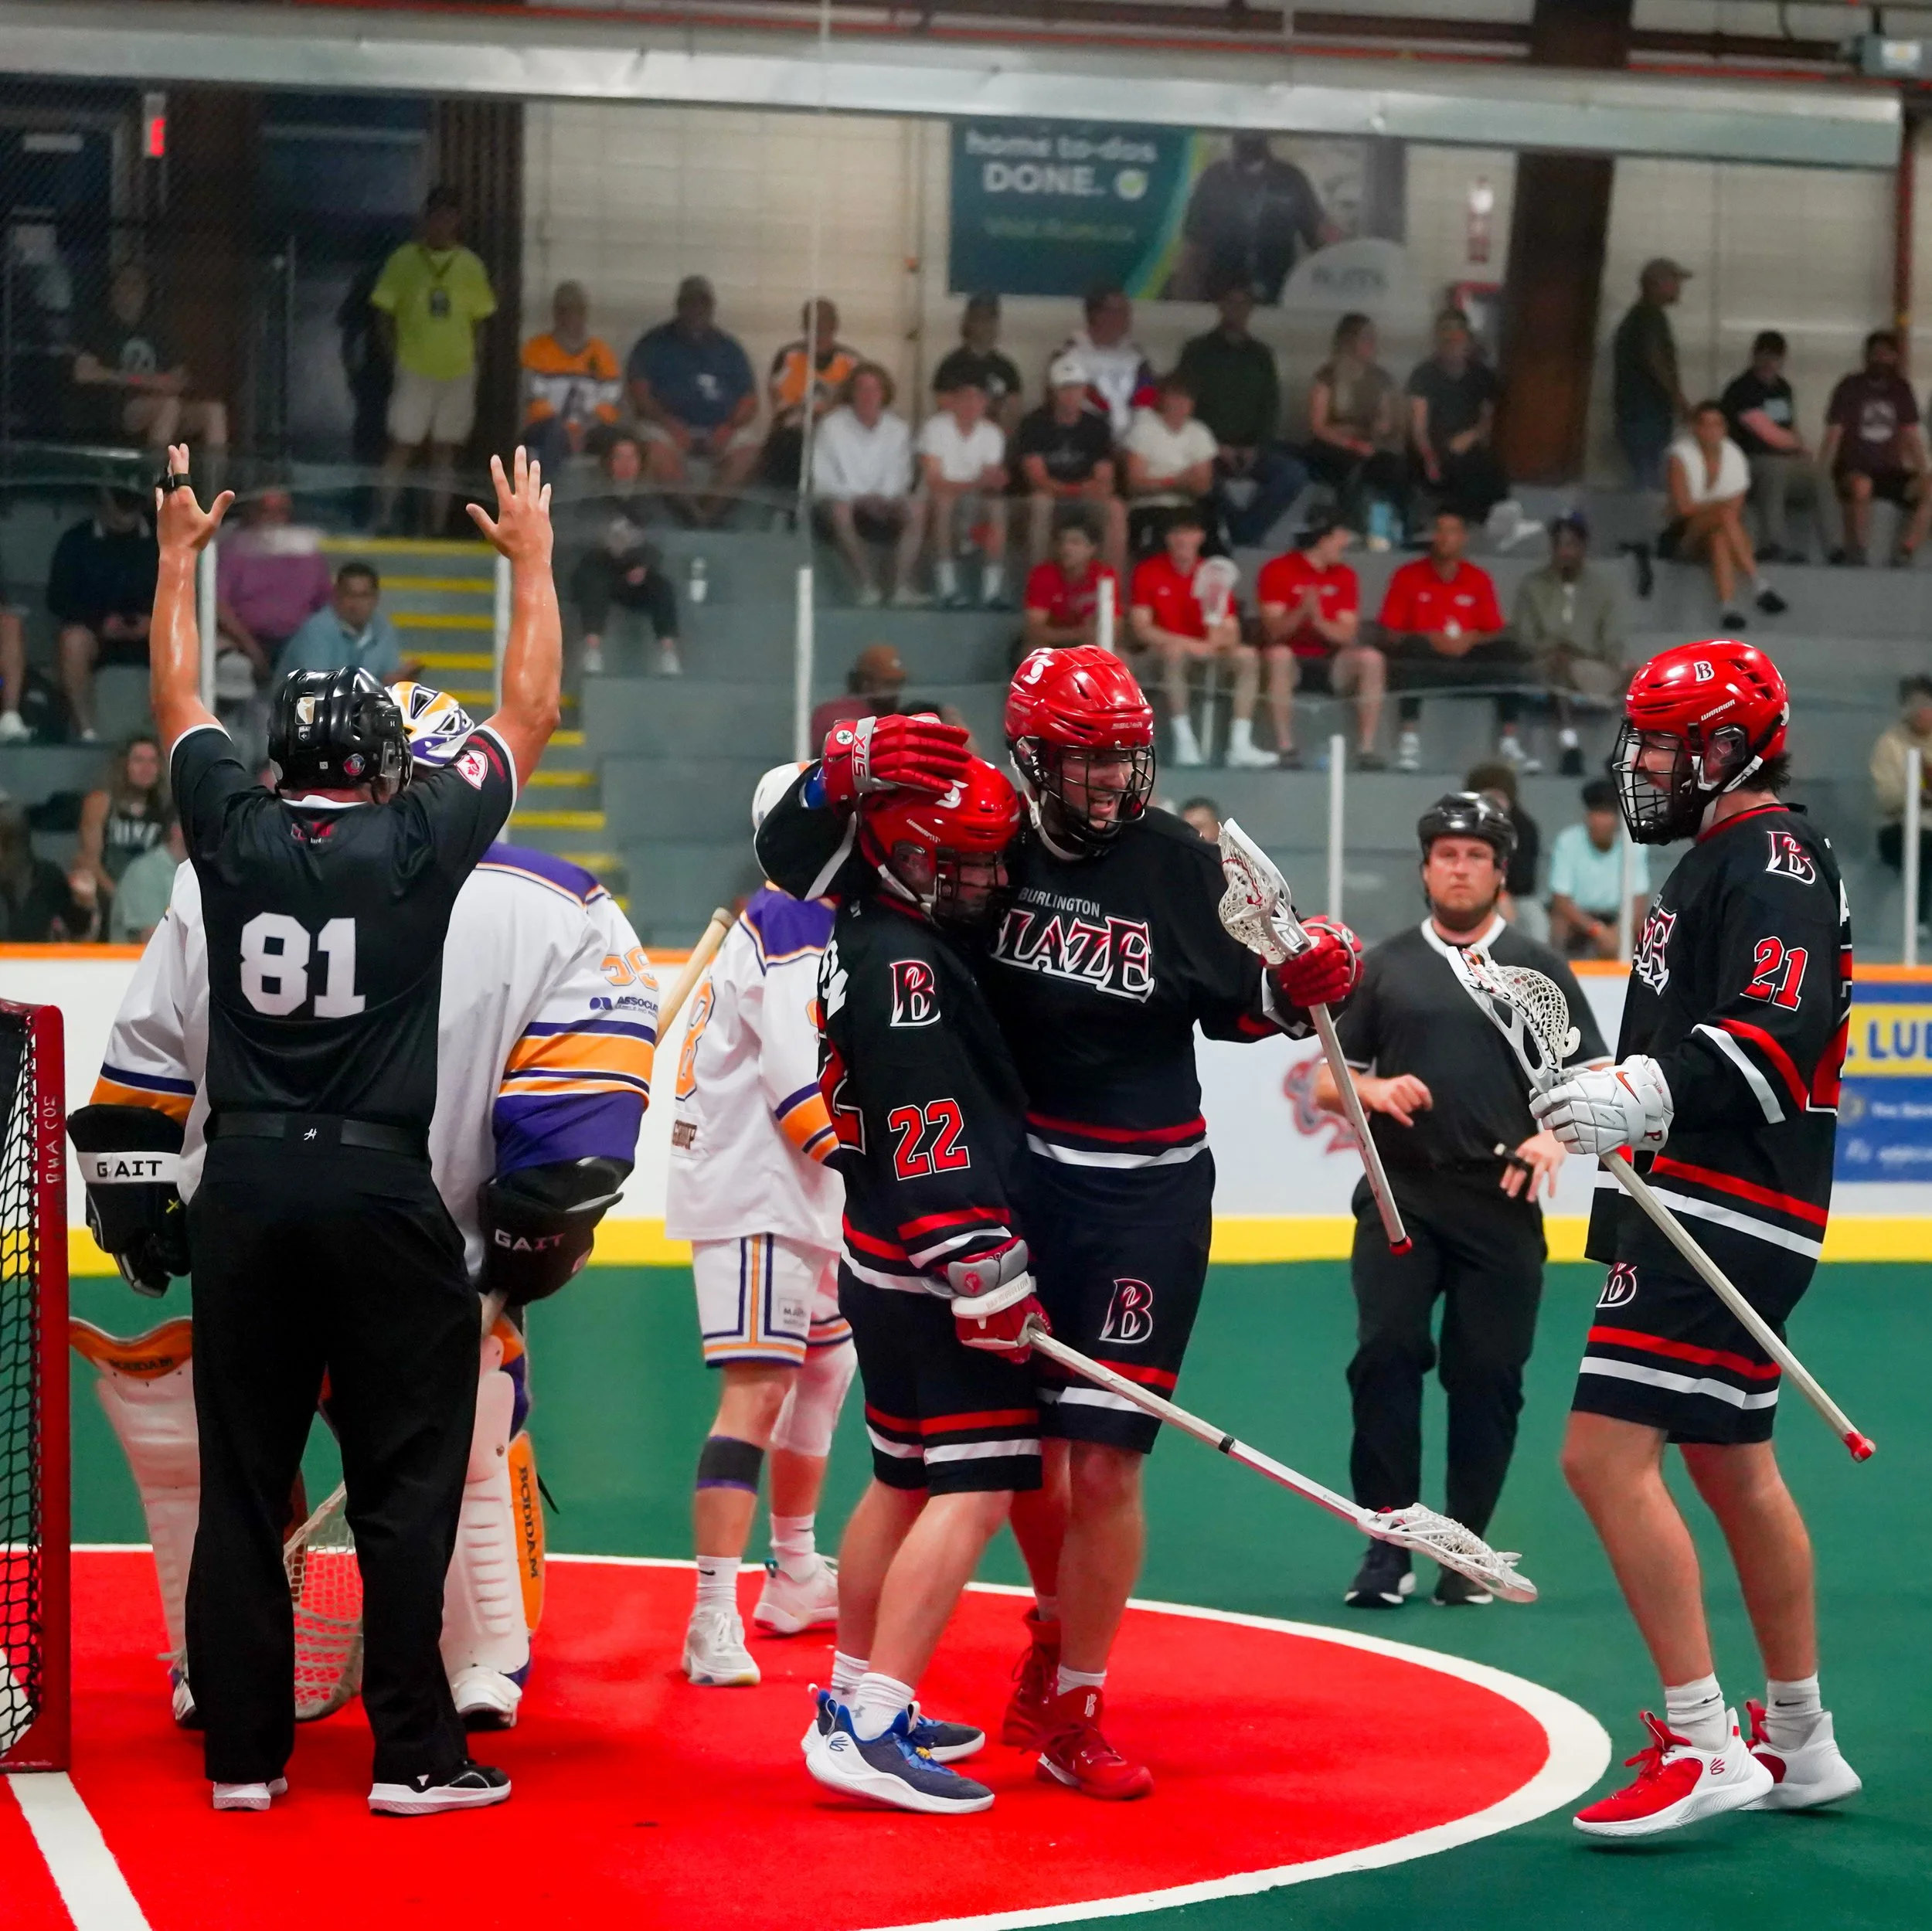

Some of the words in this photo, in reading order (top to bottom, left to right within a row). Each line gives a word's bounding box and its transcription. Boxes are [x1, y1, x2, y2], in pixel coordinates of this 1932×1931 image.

[983, 161, 1107, 196] DONE.
[1693, 661, 1715, 682] B
[1701, 699, 1736, 721] WARRIOR
[852, 733, 868, 778] STX
[1765, 831, 1816, 885] B
[1018, 888, 1100, 918] BURLINGTON
[240, 912, 366, 1018] 81
[991, 909, 1155, 1003] LAZE
[1740, 936, 1808, 1012] 21
[889, 959, 941, 1028] B
[887, 1097, 971, 1181] 22
[97, 1160, 163, 1178] GAIT
[495, 1228, 566, 1252] GAIT
[1098, 1278, 1153, 1344] B
